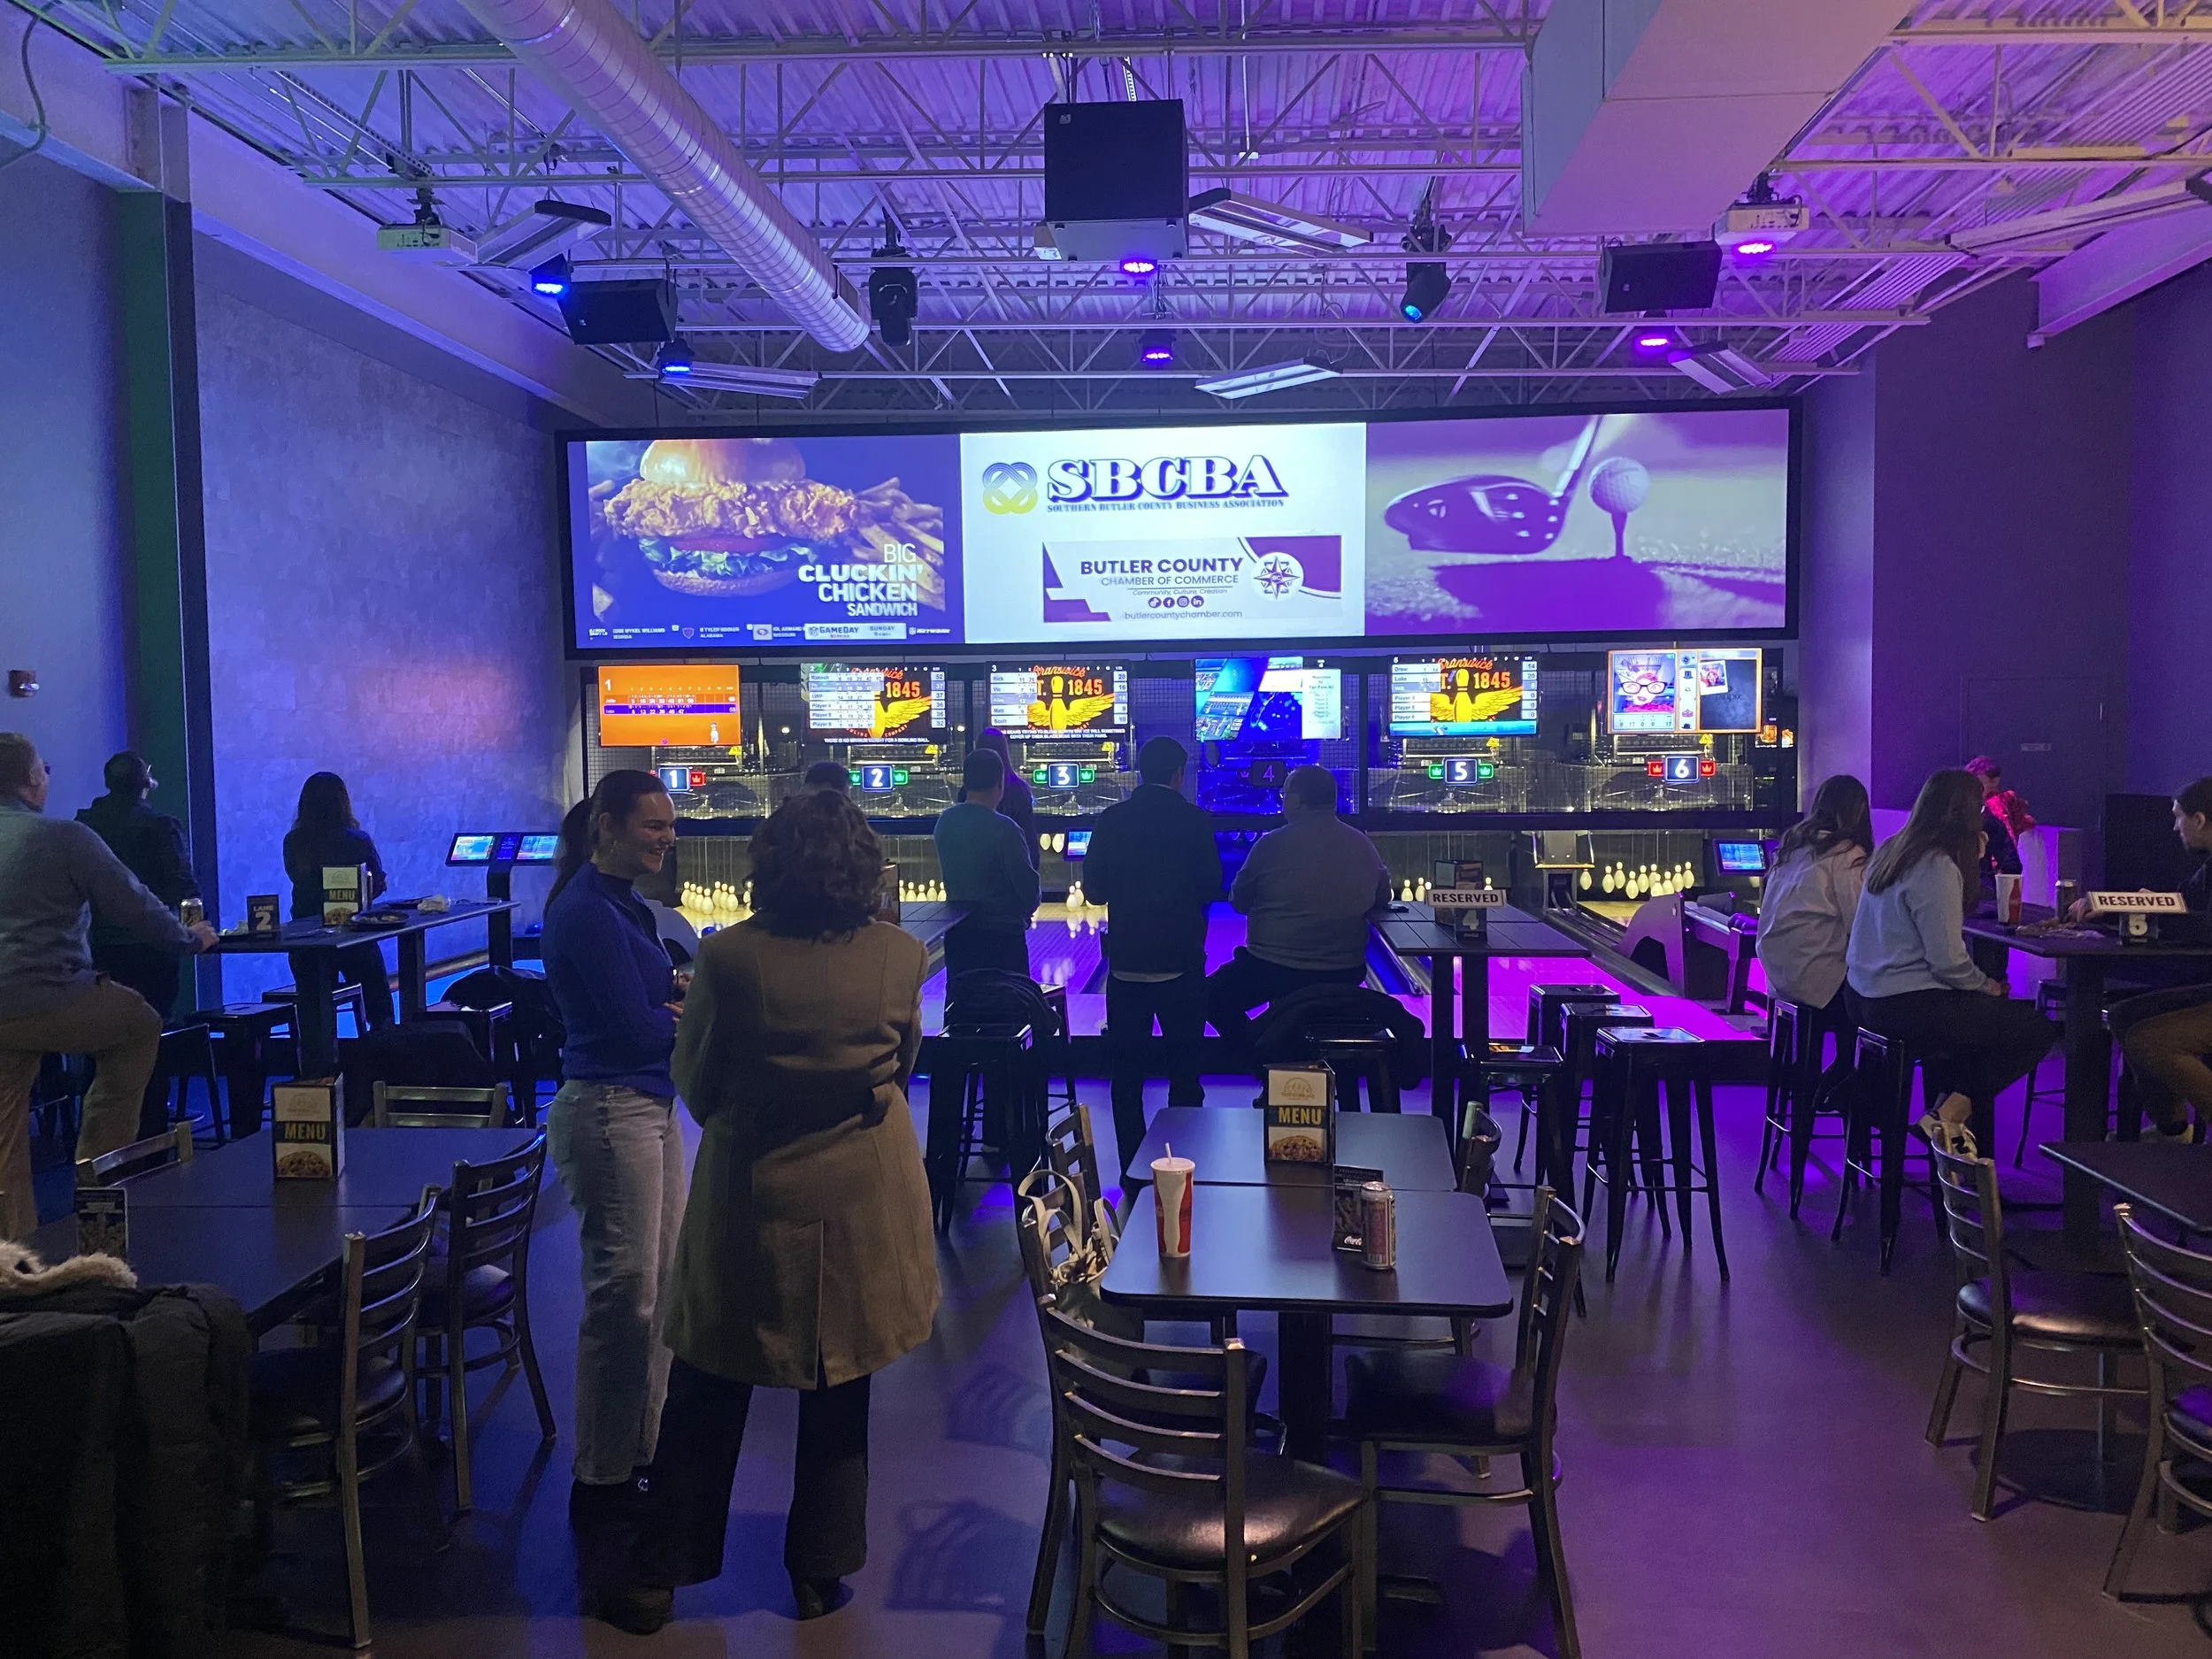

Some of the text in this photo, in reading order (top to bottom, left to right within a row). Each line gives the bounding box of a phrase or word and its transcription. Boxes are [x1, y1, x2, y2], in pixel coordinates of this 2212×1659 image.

[1048, 455, 1288, 502] SBCBA
[1048, 499, 1284, 512] SOUTHERN BUTLER COUNTY BUSINESS ASSOCIATION
[884, 543, 916, 563] BIG
[798, 564, 924, 582] CLUCKIN'
[1080, 558, 1243, 574] BUTLER COUNTY
[1101, 575, 1239, 587] CHAMBER OF COMMERCE
[818, 583, 918, 602] CHICKEN
[847, 603, 918, 617] SANDWICH
[1125, 611, 1242, 620] butlercountychamber.com
[604, 680, 611, 691] 1
[886, 681, 920, 697] 1845
[1068, 679, 1102, 695] 1845
[1474, 672, 1510, 689] 1845
[872, 768, 883, 787] 2
[1057, 766, 1070, 785] 3
[1263, 764, 1274, 782] 4
[1455, 762, 1467, 780] 5
[1675, 759, 1689, 778] 6
[670, 770, 677, 788] 1
[329, 889, 355, 901] MENU
[1432, 894, 1498, 902] RESERVED
[2098, 895, 2175, 907] RESERVED
[255, 911, 272, 931] 2
[1463, 910, 1479, 930] 4
[2128, 913, 2147, 935] 5
[1279, 1107, 1322, 1125] MENU
[285, 1124, 326, 1141] MENU
